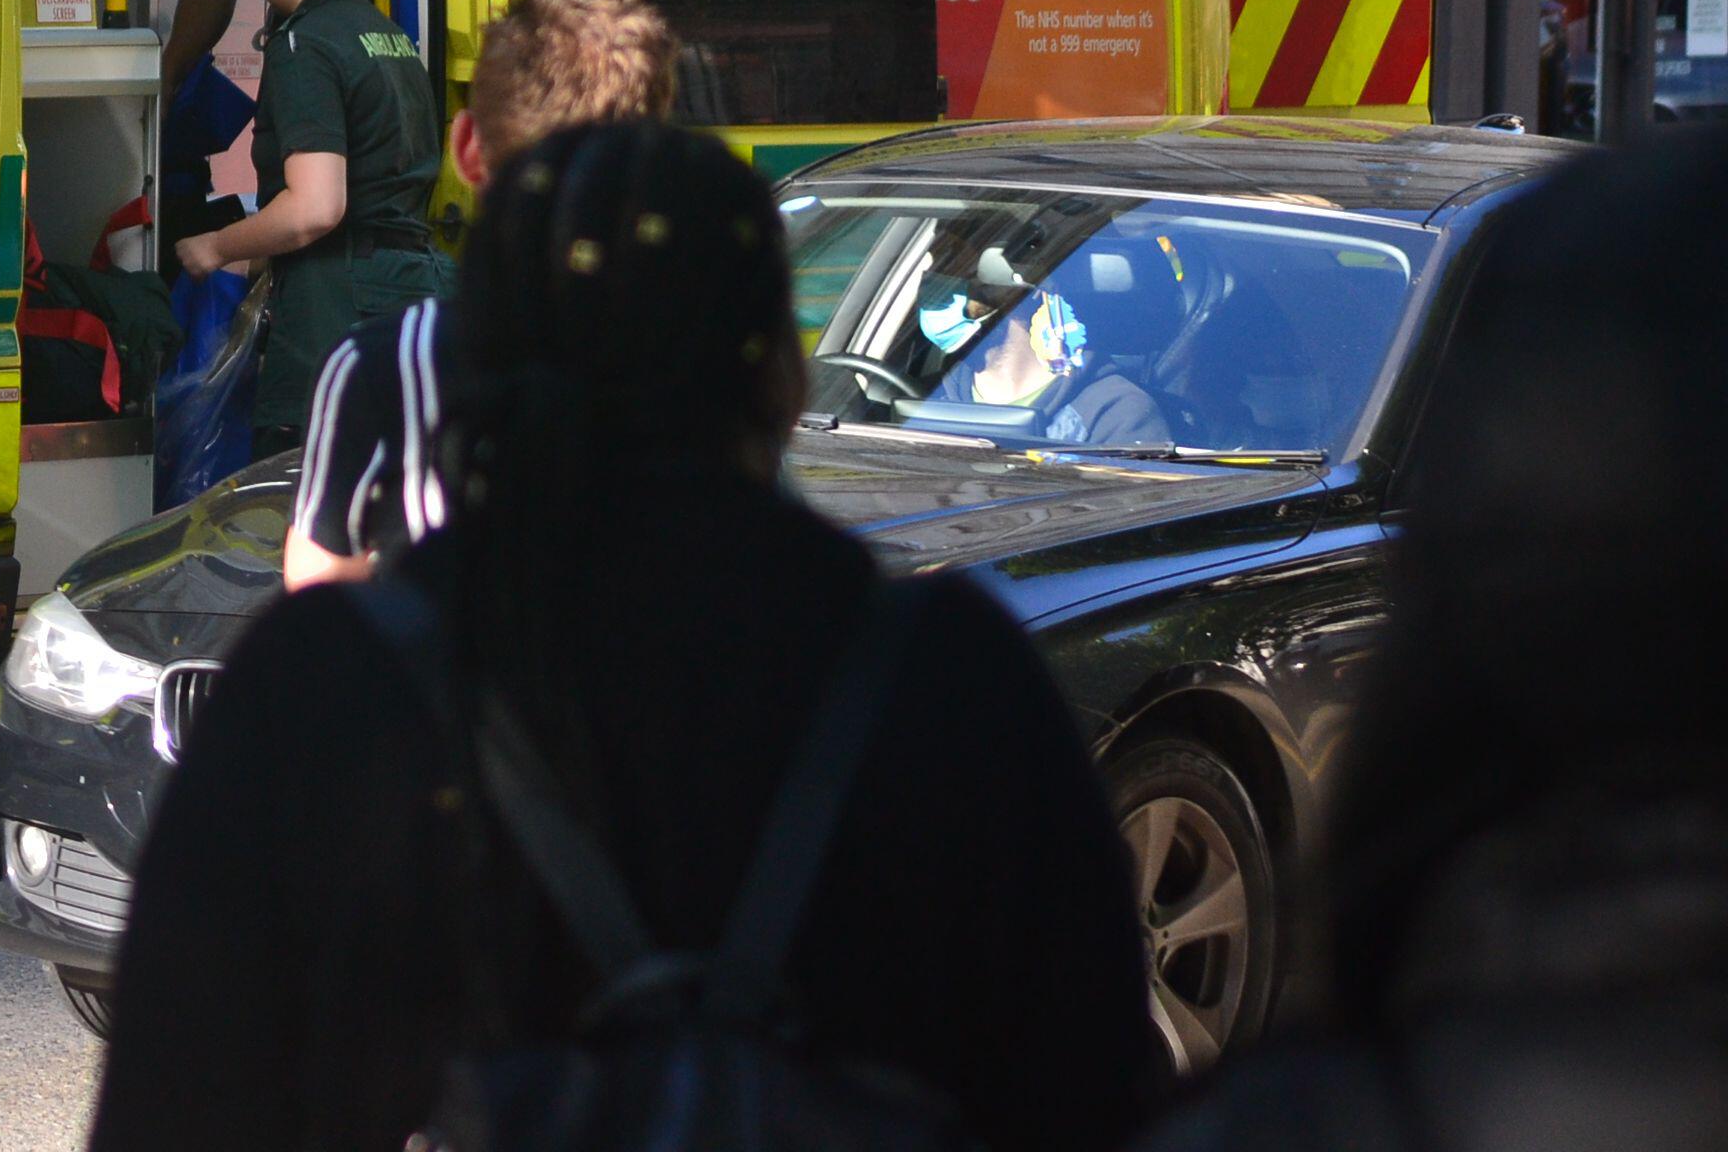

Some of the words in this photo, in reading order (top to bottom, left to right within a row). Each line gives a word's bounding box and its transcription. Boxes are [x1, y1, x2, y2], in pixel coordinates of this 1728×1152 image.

[52, 7, 77, 20] SCREEN
[1015, 10, 1035, 28] The
[1038, 10, 1059, 28] NHS
[1063, 11, 1103, 29] number
[1107, 12, 1135, 29] when
[1138, 11, 1153, 29] it's
[1029, 36, 1047, 53] not
[1051, 40, 1057, 53] a
[1060, 35, 1080, 53] 999
[1083, 38, 1141, 56] emergency
